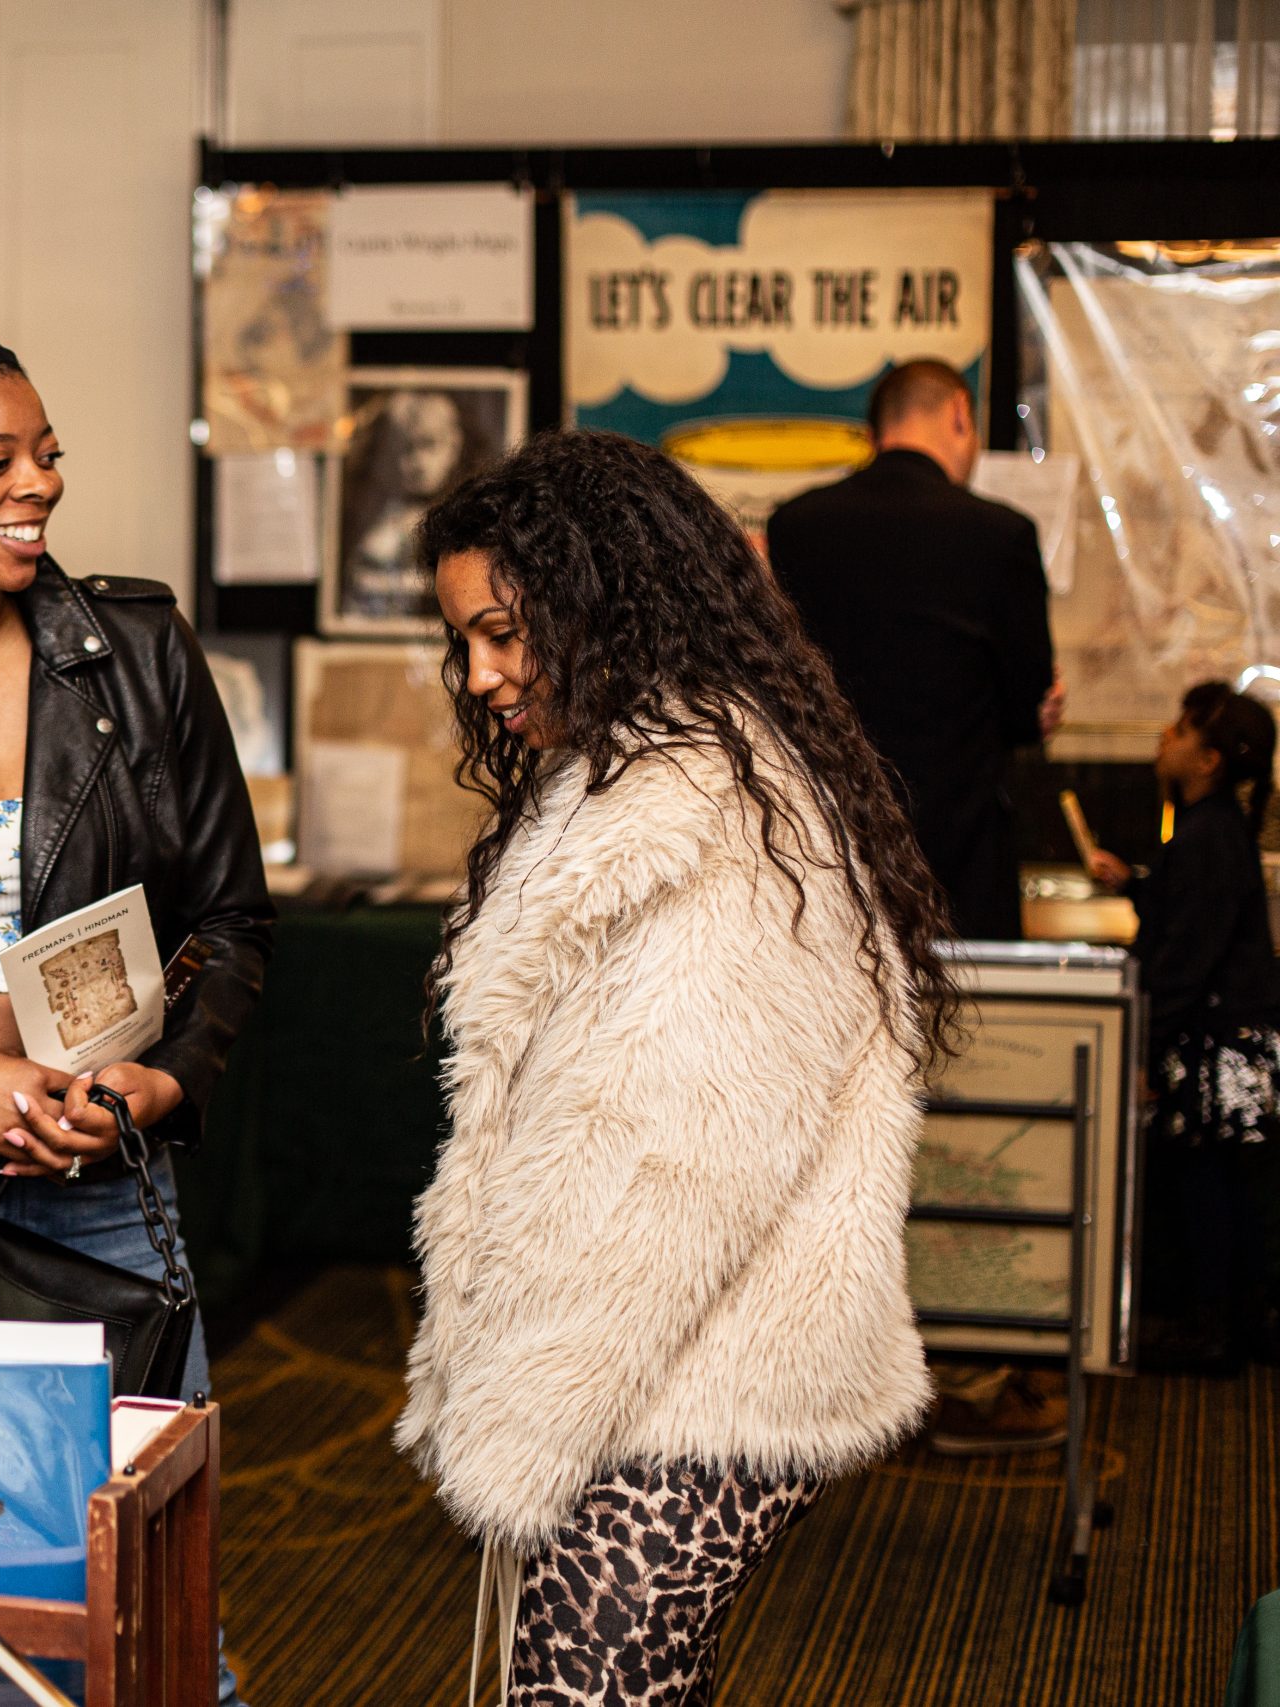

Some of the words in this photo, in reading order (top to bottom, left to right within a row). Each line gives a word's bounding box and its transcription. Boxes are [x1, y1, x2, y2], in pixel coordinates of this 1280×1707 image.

[587, 264, 673, 330] LET'S
[687, 267, 796, 331] CLEAR
[811, 267, 879, 329] THE
[892, 267, 961, 330] AIR
[22, 932, 75, 963] FREEMAN'S
[84, 907, 129, 932] HINDMAN
